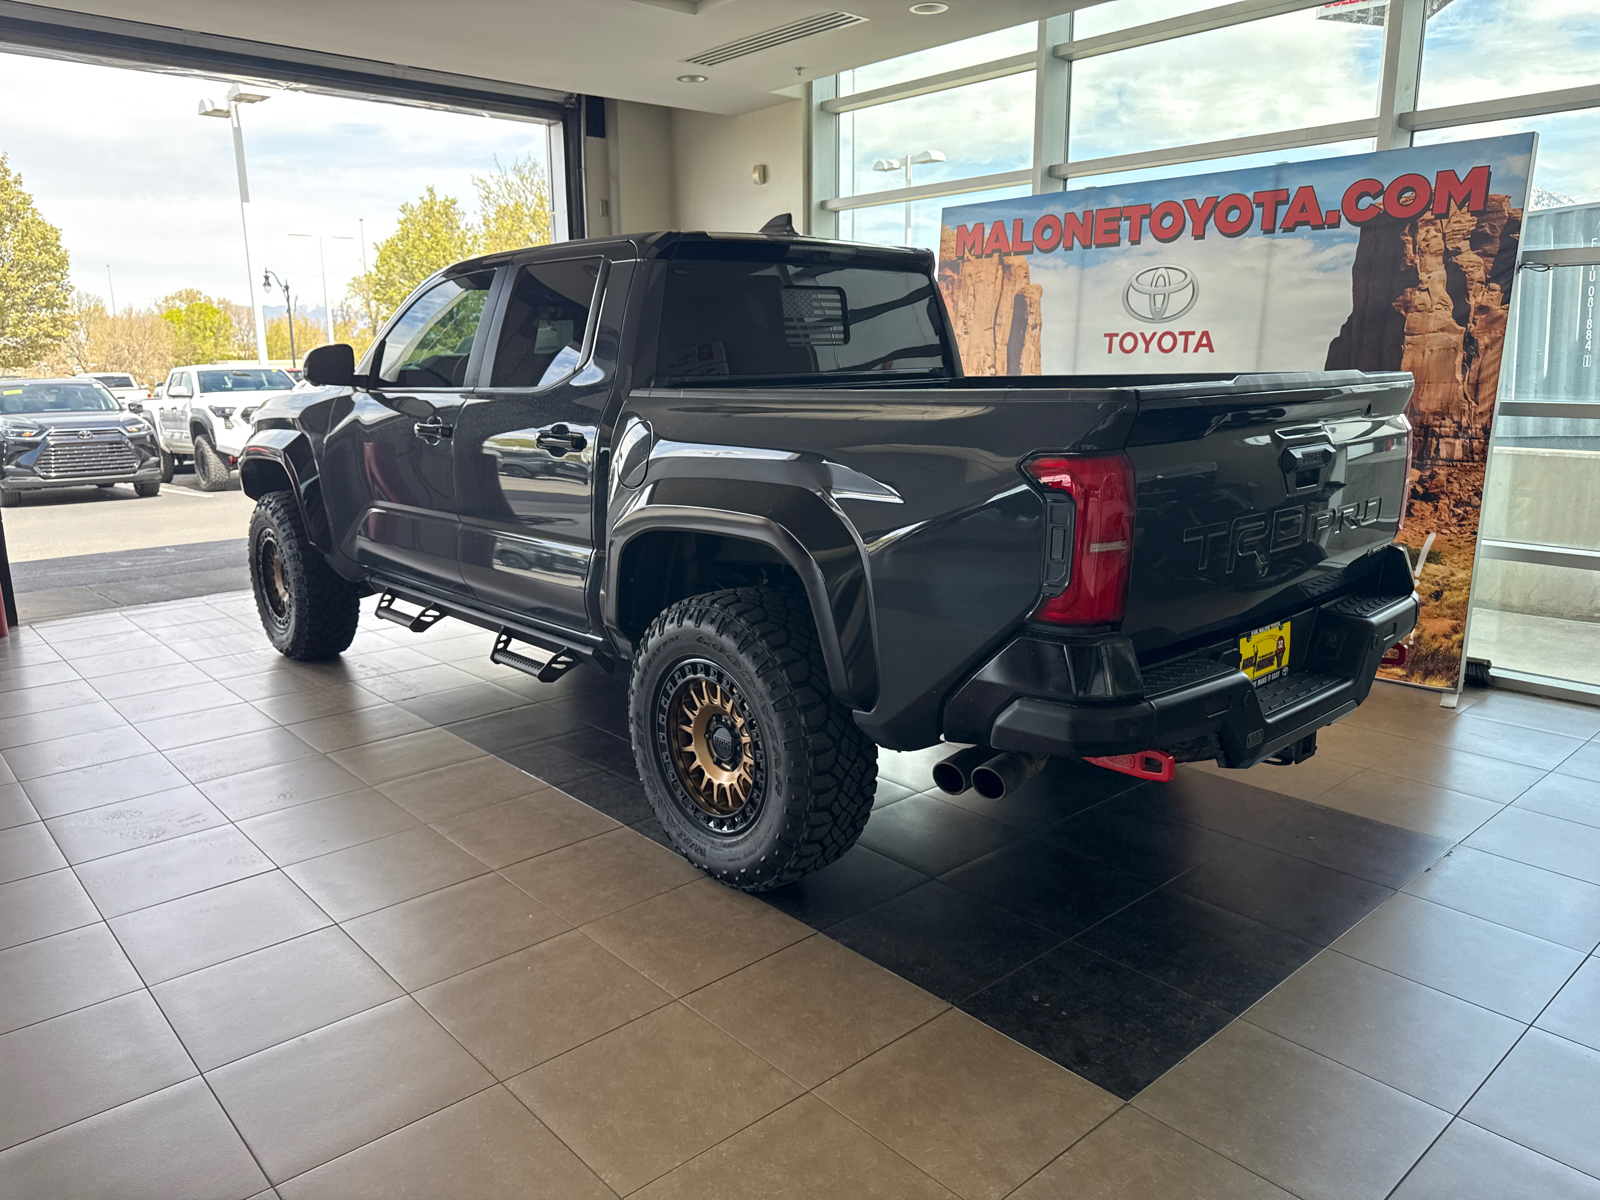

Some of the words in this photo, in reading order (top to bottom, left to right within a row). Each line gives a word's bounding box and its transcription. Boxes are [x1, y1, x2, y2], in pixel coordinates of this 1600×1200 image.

[956, 165, 1492, 258] MALONETOYOTA.COM
[1103, 330, 1215, 355] TOYOTA
[1584, 285, 1595, 351] 081884
[1183, 504, 1307, 577] TRD
[1307, 496, 1383, 543] PRO
[639, 634, 683, 687] DURATRAC
[1258, 676, 1267, 686] MAKE
[1271, 670, 1280, 680] EASY
[695, 634, 783, 798] GOODYEAR
